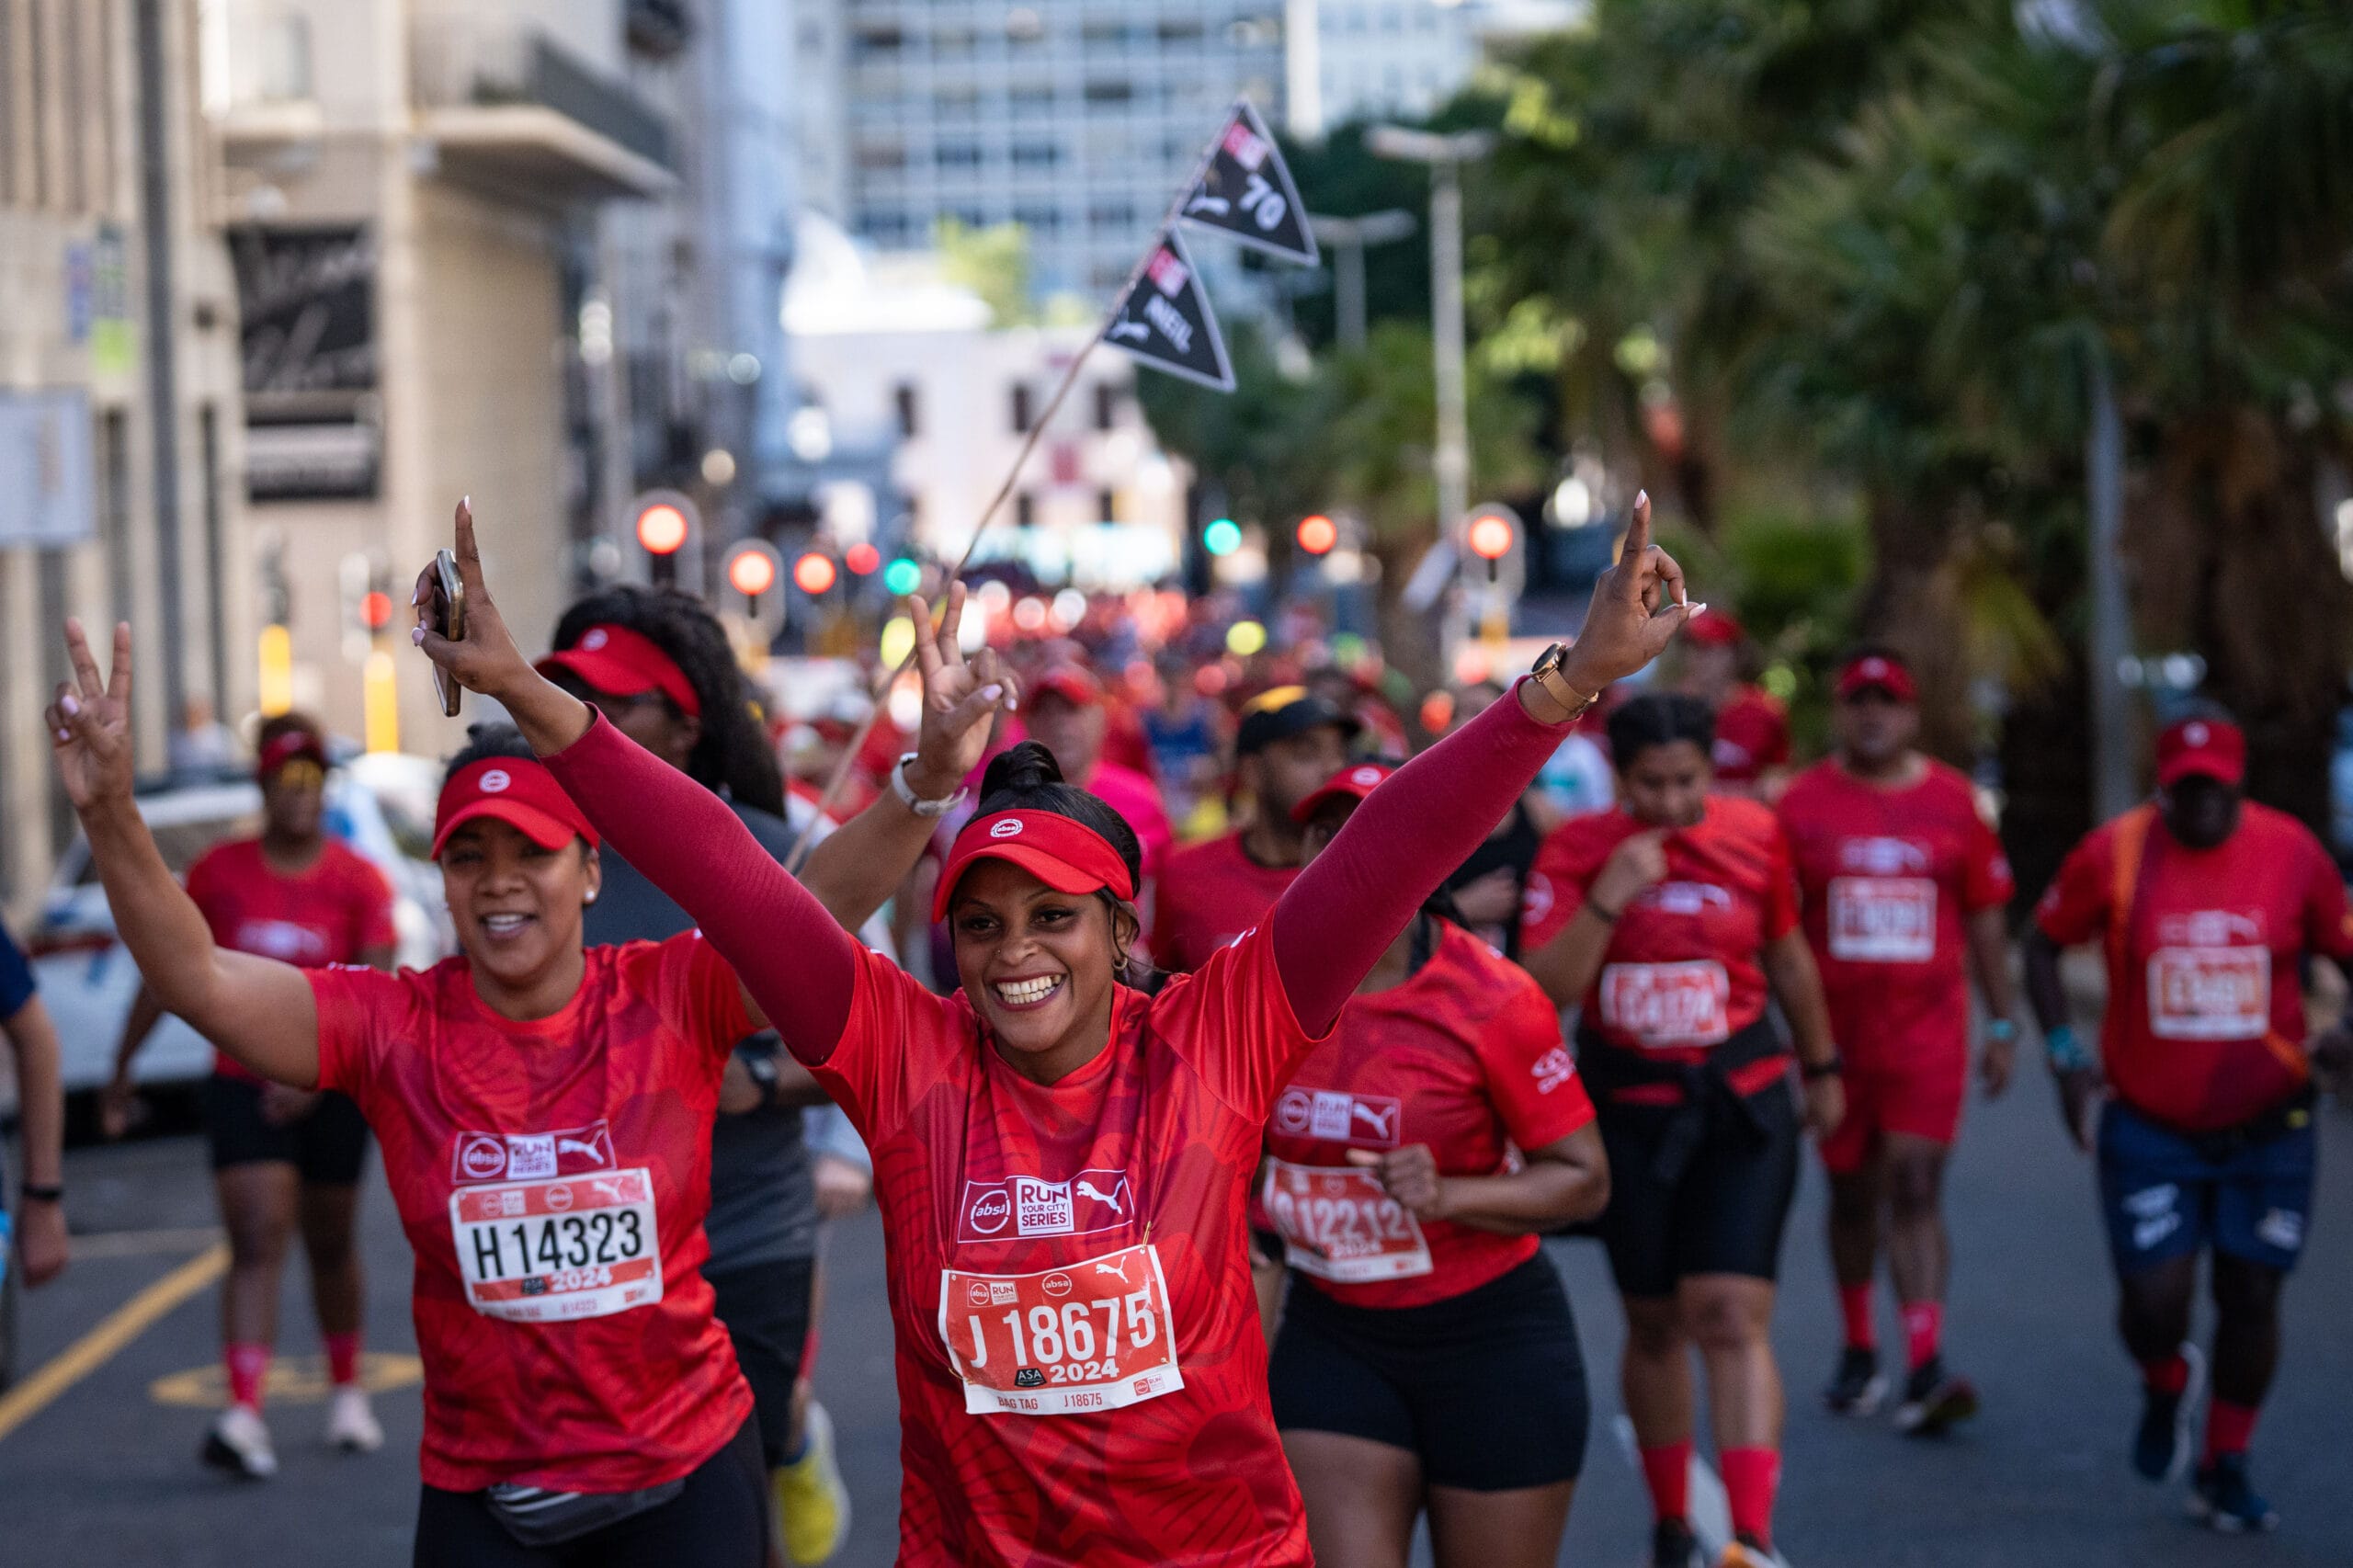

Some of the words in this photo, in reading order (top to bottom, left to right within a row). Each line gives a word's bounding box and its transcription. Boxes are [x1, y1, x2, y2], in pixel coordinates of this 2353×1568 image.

[1239, 172, 1287, 232] 70
[1143, 293, 1193, 355] NEIL
[1021, 1184, 1068, 1204] RUN
[975, 1202, 1006, 1217] absa
[1021, 1204, 1045, 1214] YOUR
[1046, 1202, 1066, 1212] CITY
[1021, 1212, 1067, 1227] SERIES
[551, 1267, 613, 1292] 2024
[1045, 1279, 1069, 1290] absa
[971, 1289, 988, 1298] absa
[992, 1286, 1014, 1295] RUN
[969, 1314, 989, 1369] J
[1002, 1290, 1156, 1368] 18675
[1017, 1369, 1042, 1380] ASA
[1049, 1358, 1120, 1383] 2024
[997, 1396, 1017, 1409] BAG
[1018, 1398, 1039, 1410] TAG
[1070, 1392, 1103, 1407] 18675
